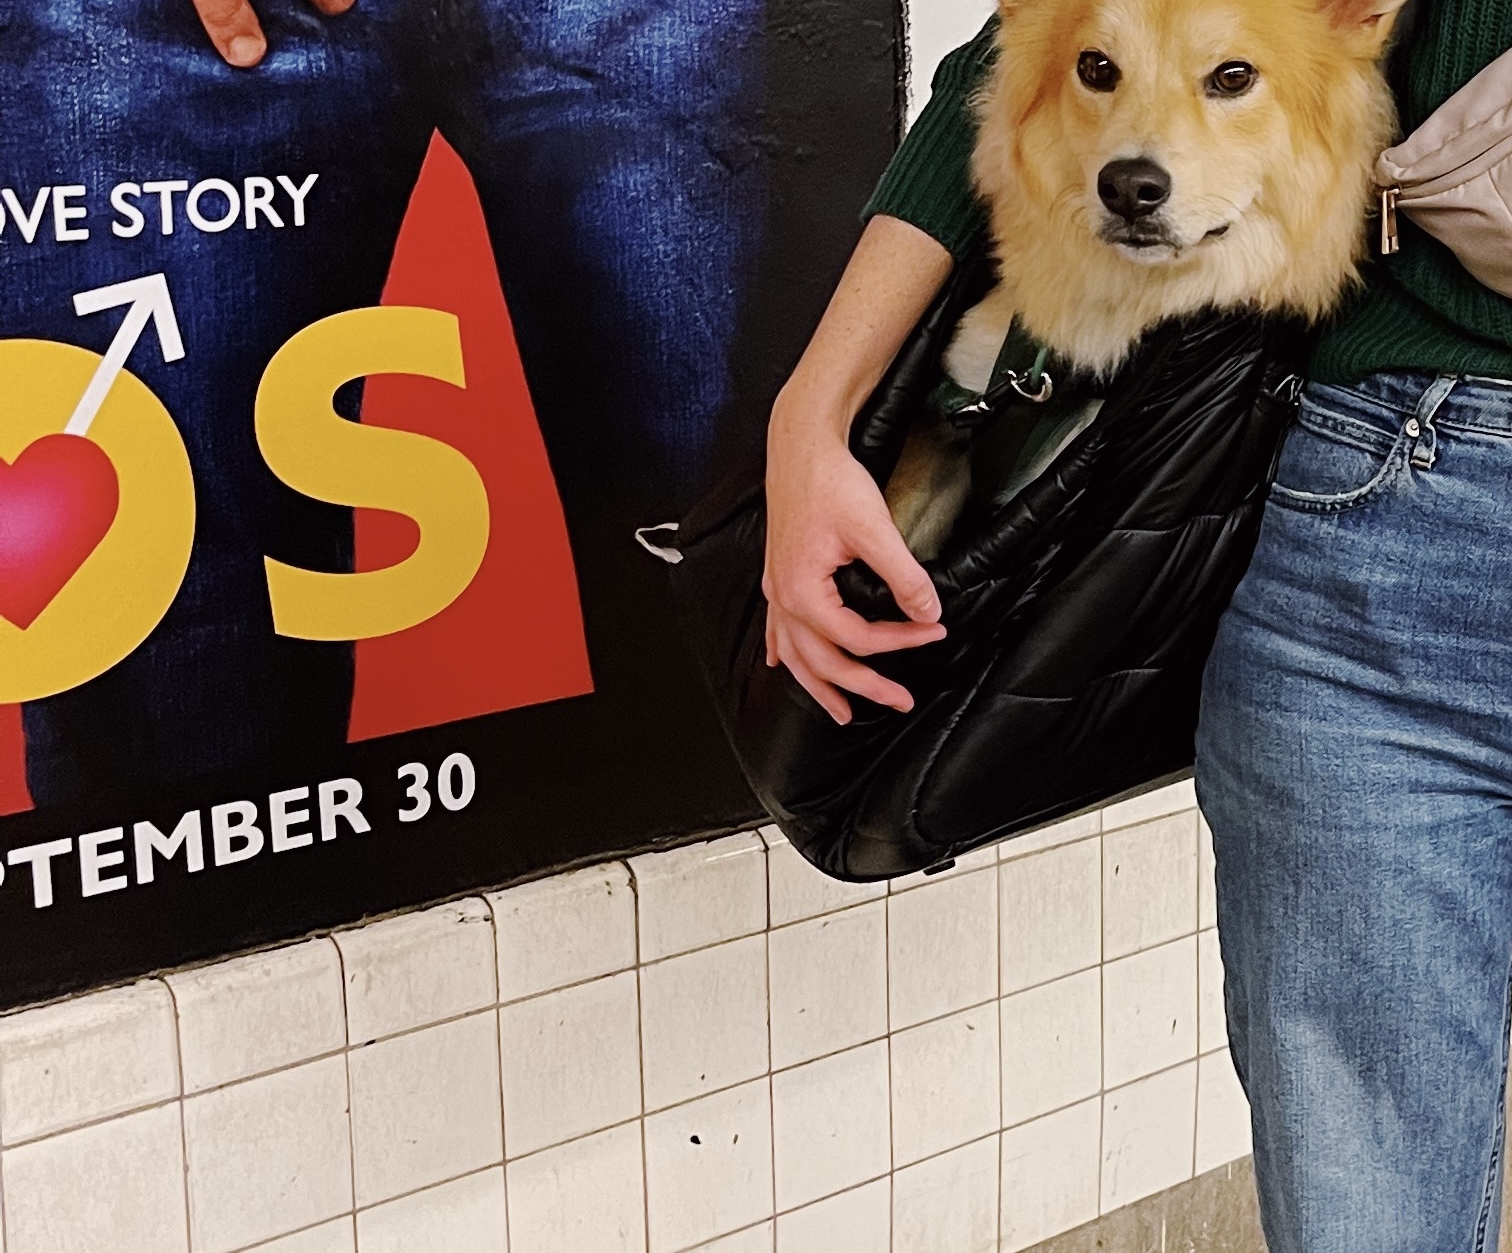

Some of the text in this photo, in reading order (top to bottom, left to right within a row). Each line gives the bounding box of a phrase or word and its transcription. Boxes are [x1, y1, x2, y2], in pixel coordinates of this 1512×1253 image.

[0, 173, 319, 243] VE STORY
[0, 752, 476, 909] TEMBER 30
